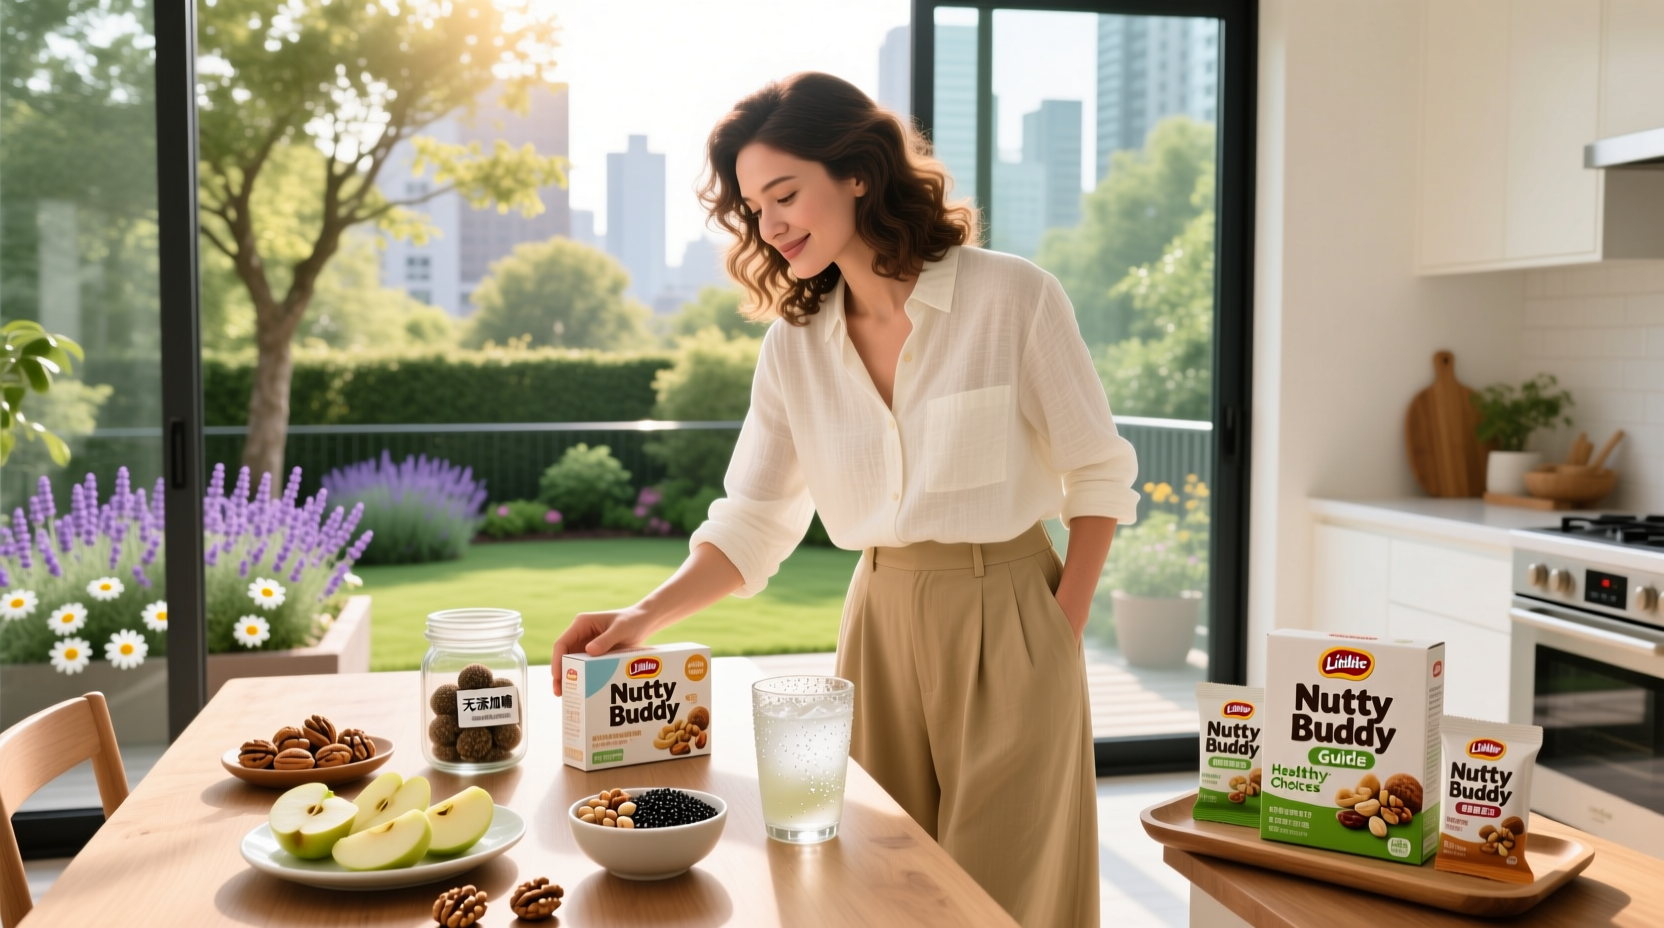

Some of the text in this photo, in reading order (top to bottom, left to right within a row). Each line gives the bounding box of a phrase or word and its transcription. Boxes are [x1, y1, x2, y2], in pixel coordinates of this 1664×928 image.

[610, 679, 677, 705] Nutty
[1295, 683, 1393, 724] Nutty
[609, 700, 680, 727] Buddy
[1207, 720, 1261, 743] Nutty
[1291, 713, 1396, 754] Buddy
[1205, 737, 1260, 759] Buddy
[1318, 749, 1367, 767] Guide
[1272, 763, 1328, 784] Healthy
[1450, 761, 1513, 789] Nutty
[1449, 780, 1513, 807] Buddy
